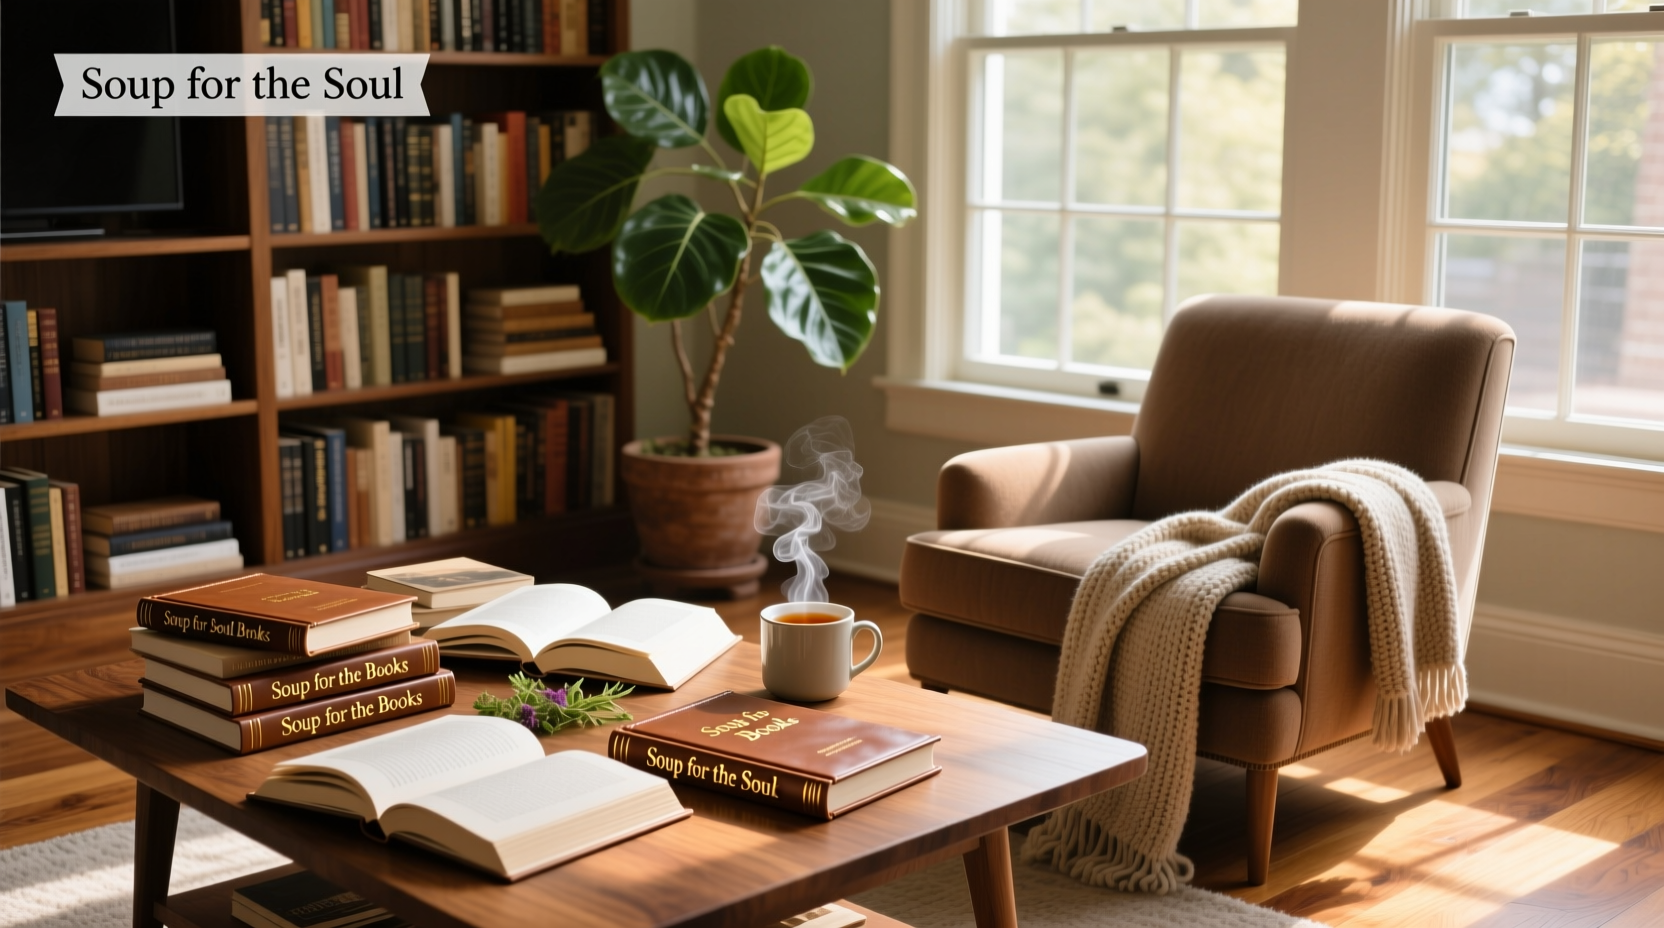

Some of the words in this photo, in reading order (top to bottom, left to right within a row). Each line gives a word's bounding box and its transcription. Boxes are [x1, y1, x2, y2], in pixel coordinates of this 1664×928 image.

[271, 681, 310, 700] Soup
[314, 672, 336, 691] for
[338, 667, 362, 686] the
[364, 656, 409, 680] Books
[281, 716, 321, 736] Soup
[325, 706, 348, 726] for
[351, 701, 375, 720] the
[378, 689, 423, 714] Books
[646, 746, 684, 779] Soup
[687, 756, 710, 780] for
[712, 763, 737, 787] the
[740, 770, 779, 798] Soul
